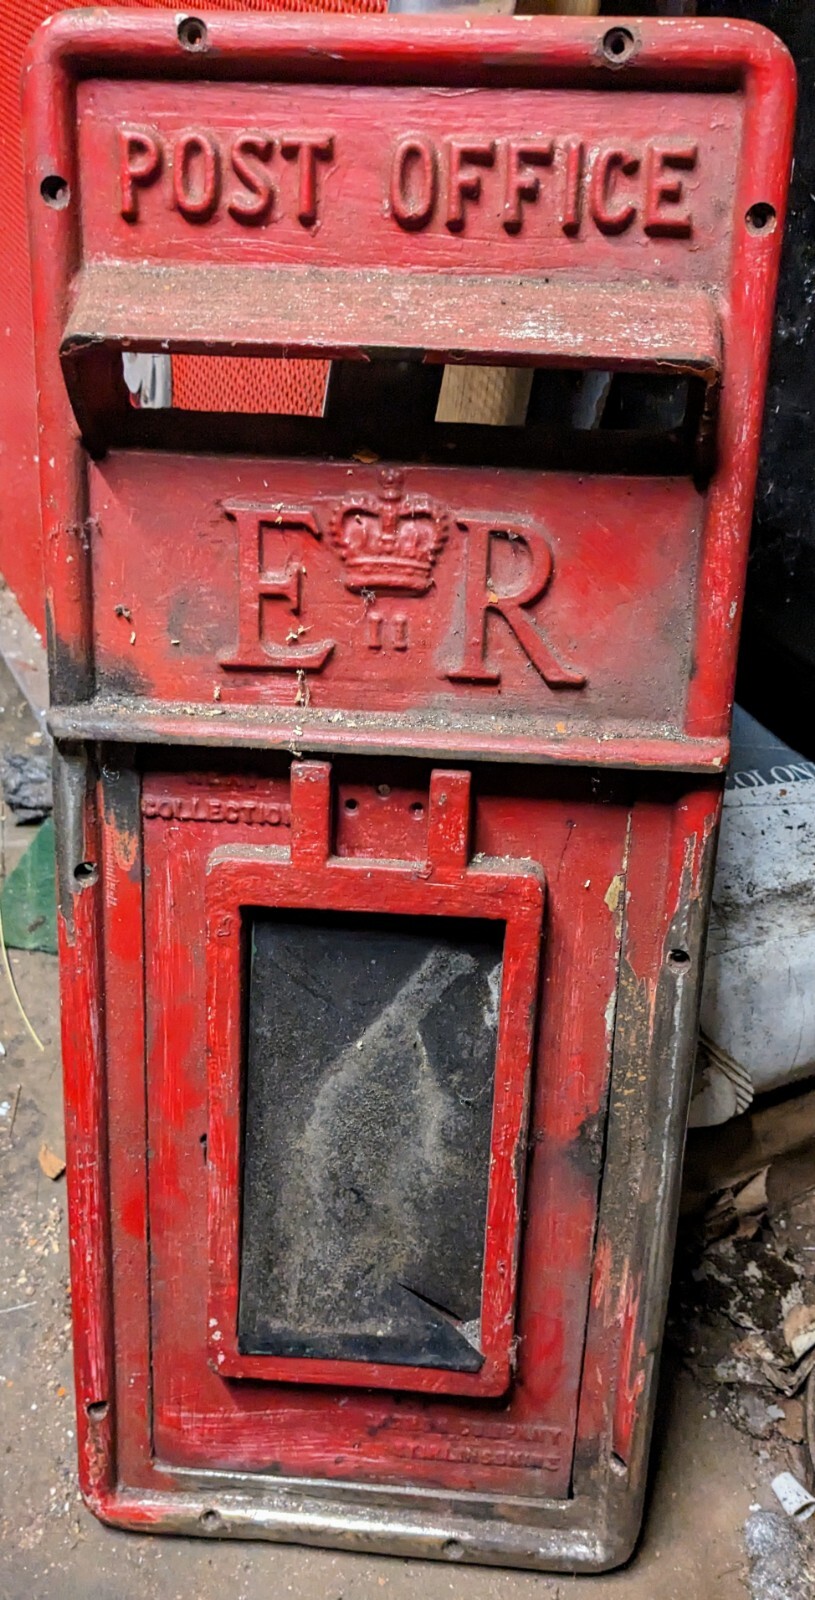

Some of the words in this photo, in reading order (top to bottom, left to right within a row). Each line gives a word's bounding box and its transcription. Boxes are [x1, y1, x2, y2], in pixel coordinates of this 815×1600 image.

[117, 123, 334, 226] POST
[389, 130, 699, 238] OFFICE
[732, 761, 815, 788] OLON
